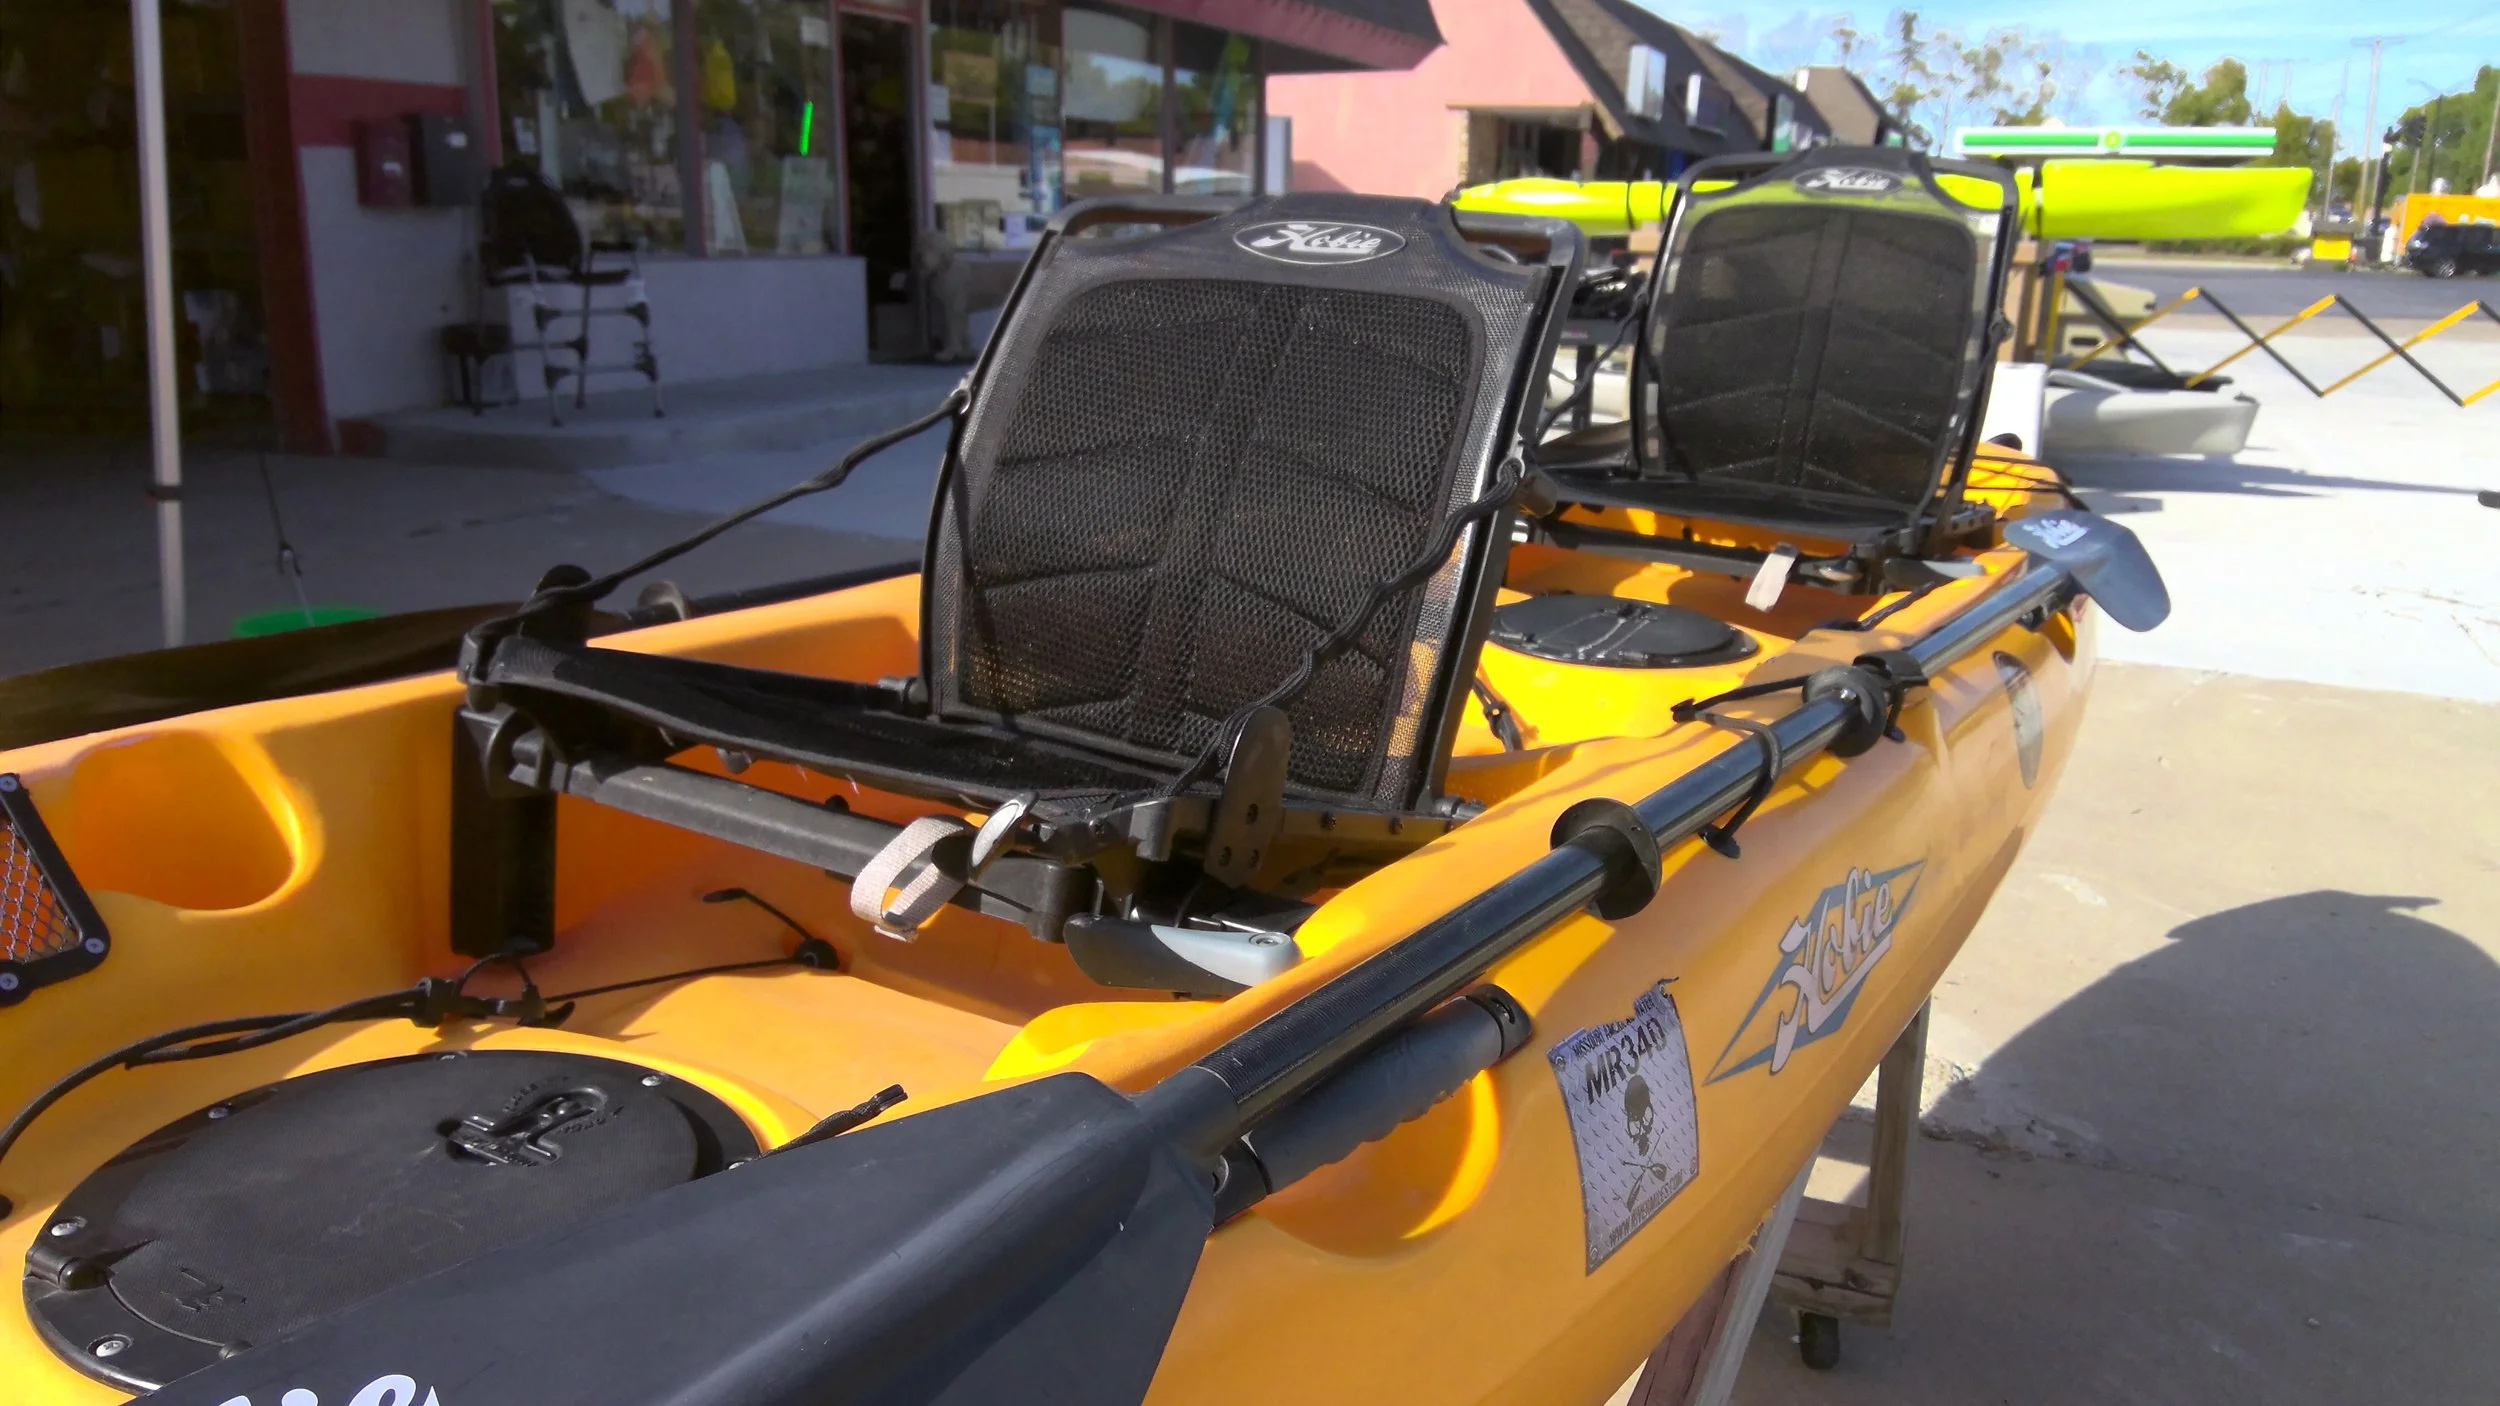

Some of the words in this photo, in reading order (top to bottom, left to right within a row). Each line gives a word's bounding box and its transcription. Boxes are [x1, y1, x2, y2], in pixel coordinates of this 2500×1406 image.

[1251, 223, 1382, 254] Hobie
[1769, 866, 1894, 1076] Hobie
[1583, 1018, 1668, 1105] MR340
